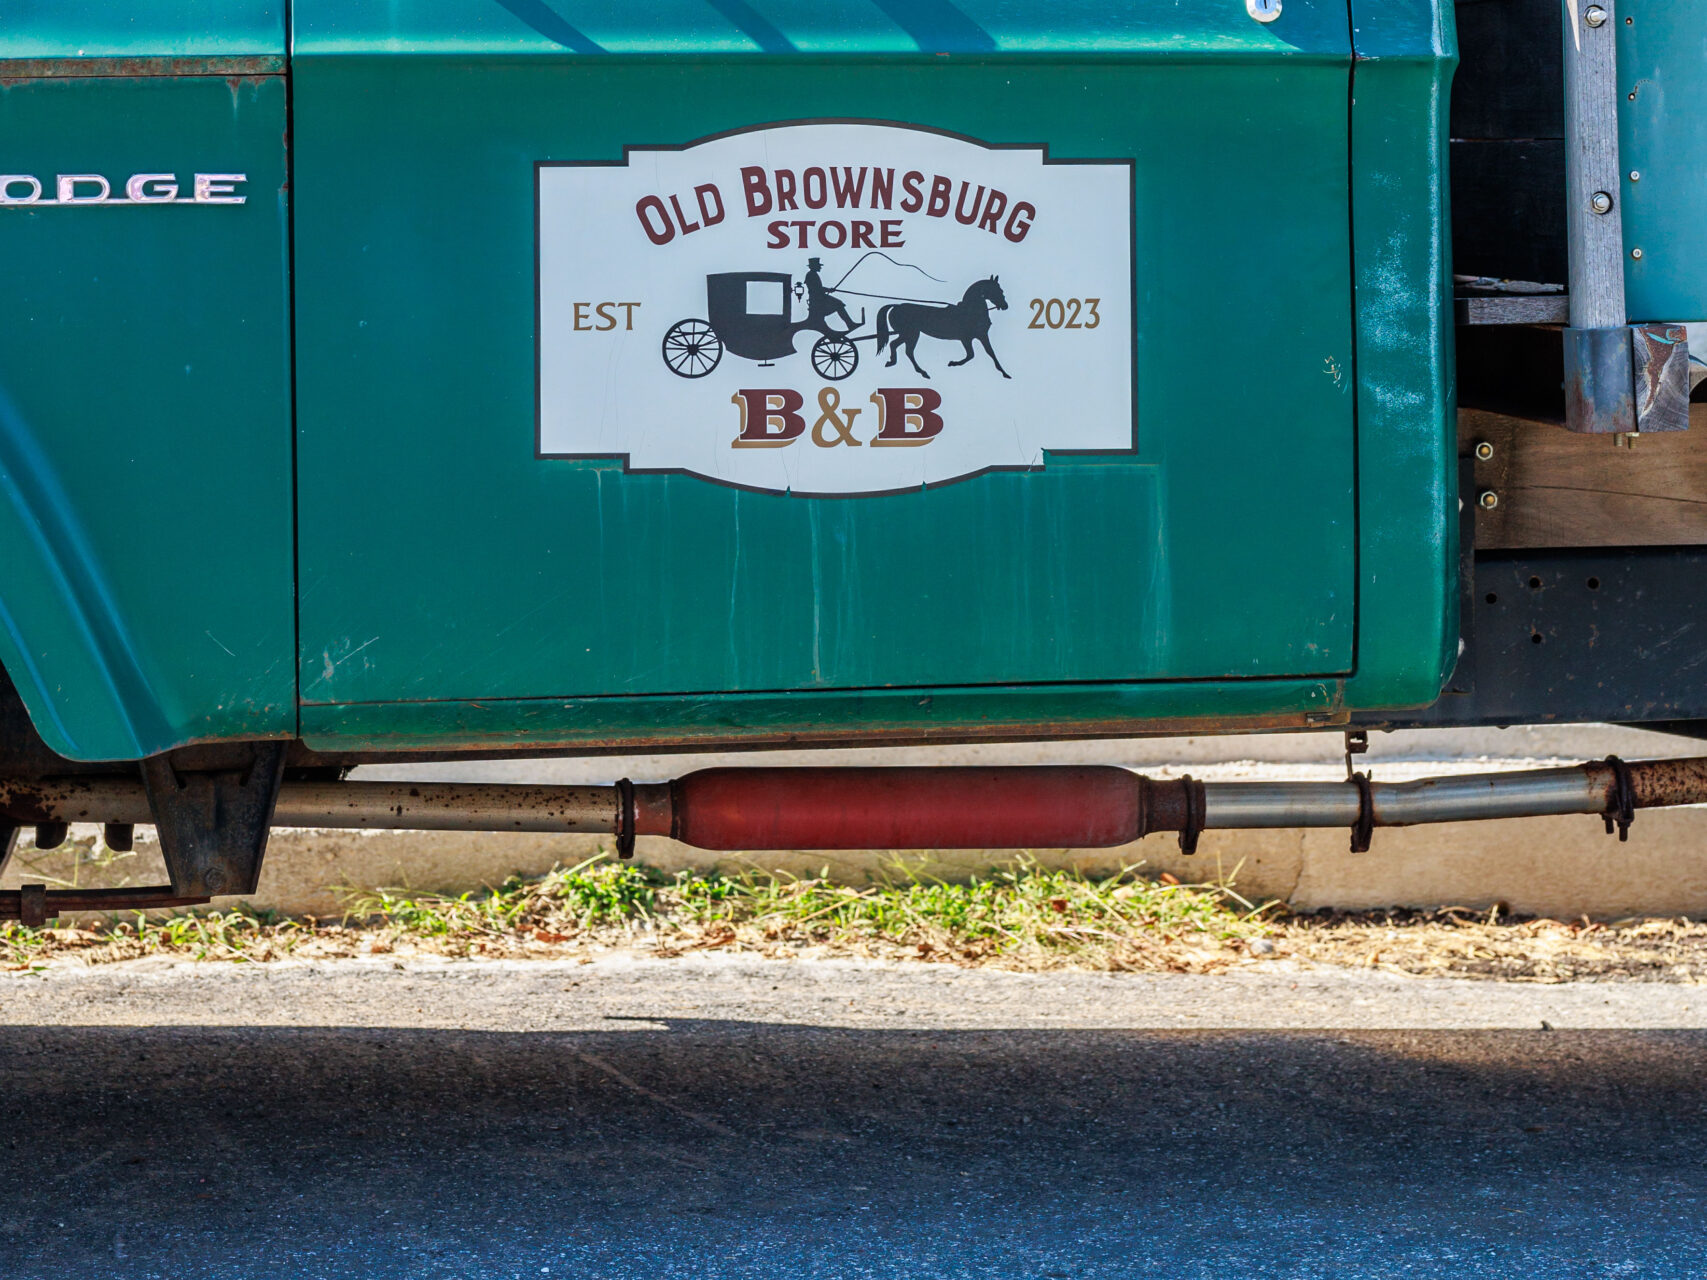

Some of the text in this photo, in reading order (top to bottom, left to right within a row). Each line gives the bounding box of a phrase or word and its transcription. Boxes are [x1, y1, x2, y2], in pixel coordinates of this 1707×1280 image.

[635, 164, 1037, 246] OLD BROWNSBURG
[766, 219, 907, 249] STORE
[572, 302, 642, 331] EST
[1027, 298, 1101, 330] 2023
[731, 386, 944, 449] B&B
